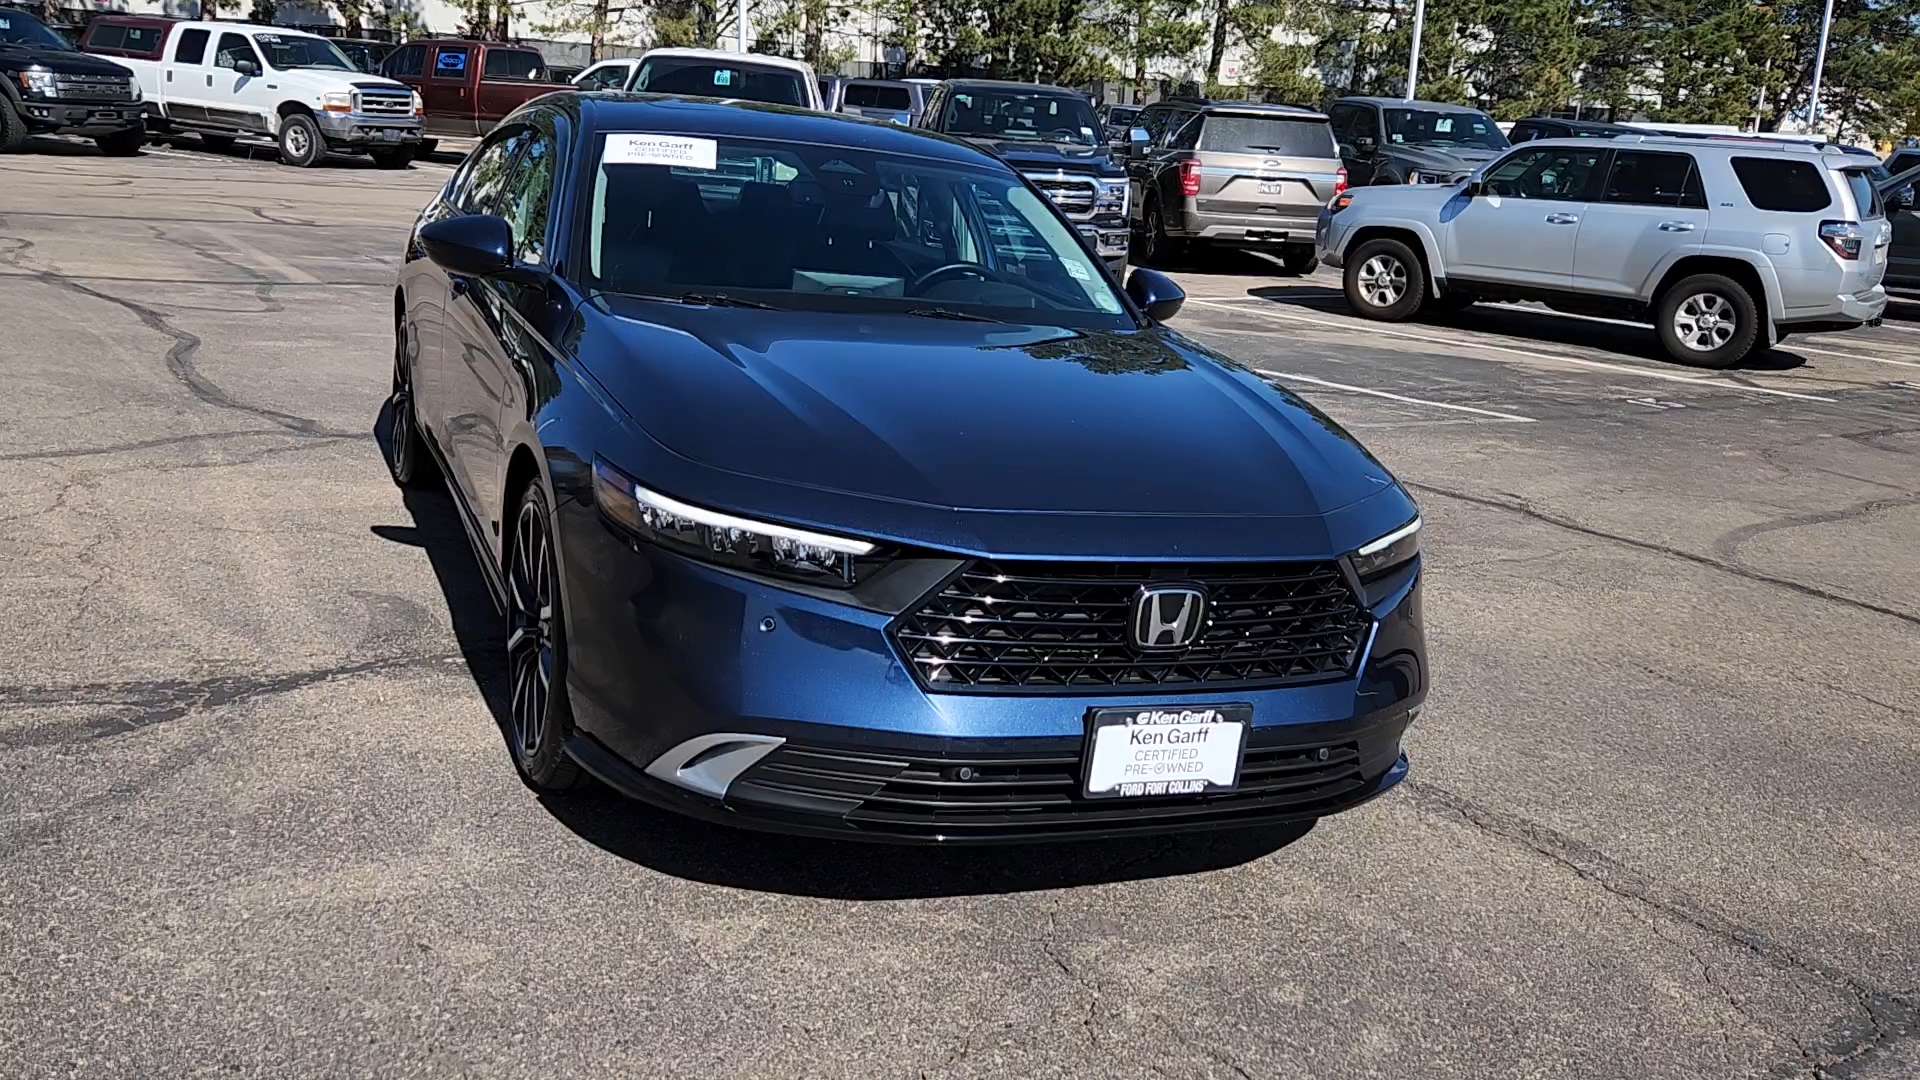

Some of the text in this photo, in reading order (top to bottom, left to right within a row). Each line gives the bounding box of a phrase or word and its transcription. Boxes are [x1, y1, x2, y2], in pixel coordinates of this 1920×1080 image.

[634, 147, 687, 155] CERTIFIED
[658, 141, 693, 150] Garff
[1179, 709, 1215, 724] Garff
[1130, 727, 1210, 745] Ken Garff
[1134, 748, 1199, 761] CERTIFIED
[1120, 780, 1204, 797] FORD FORT COLLINS
